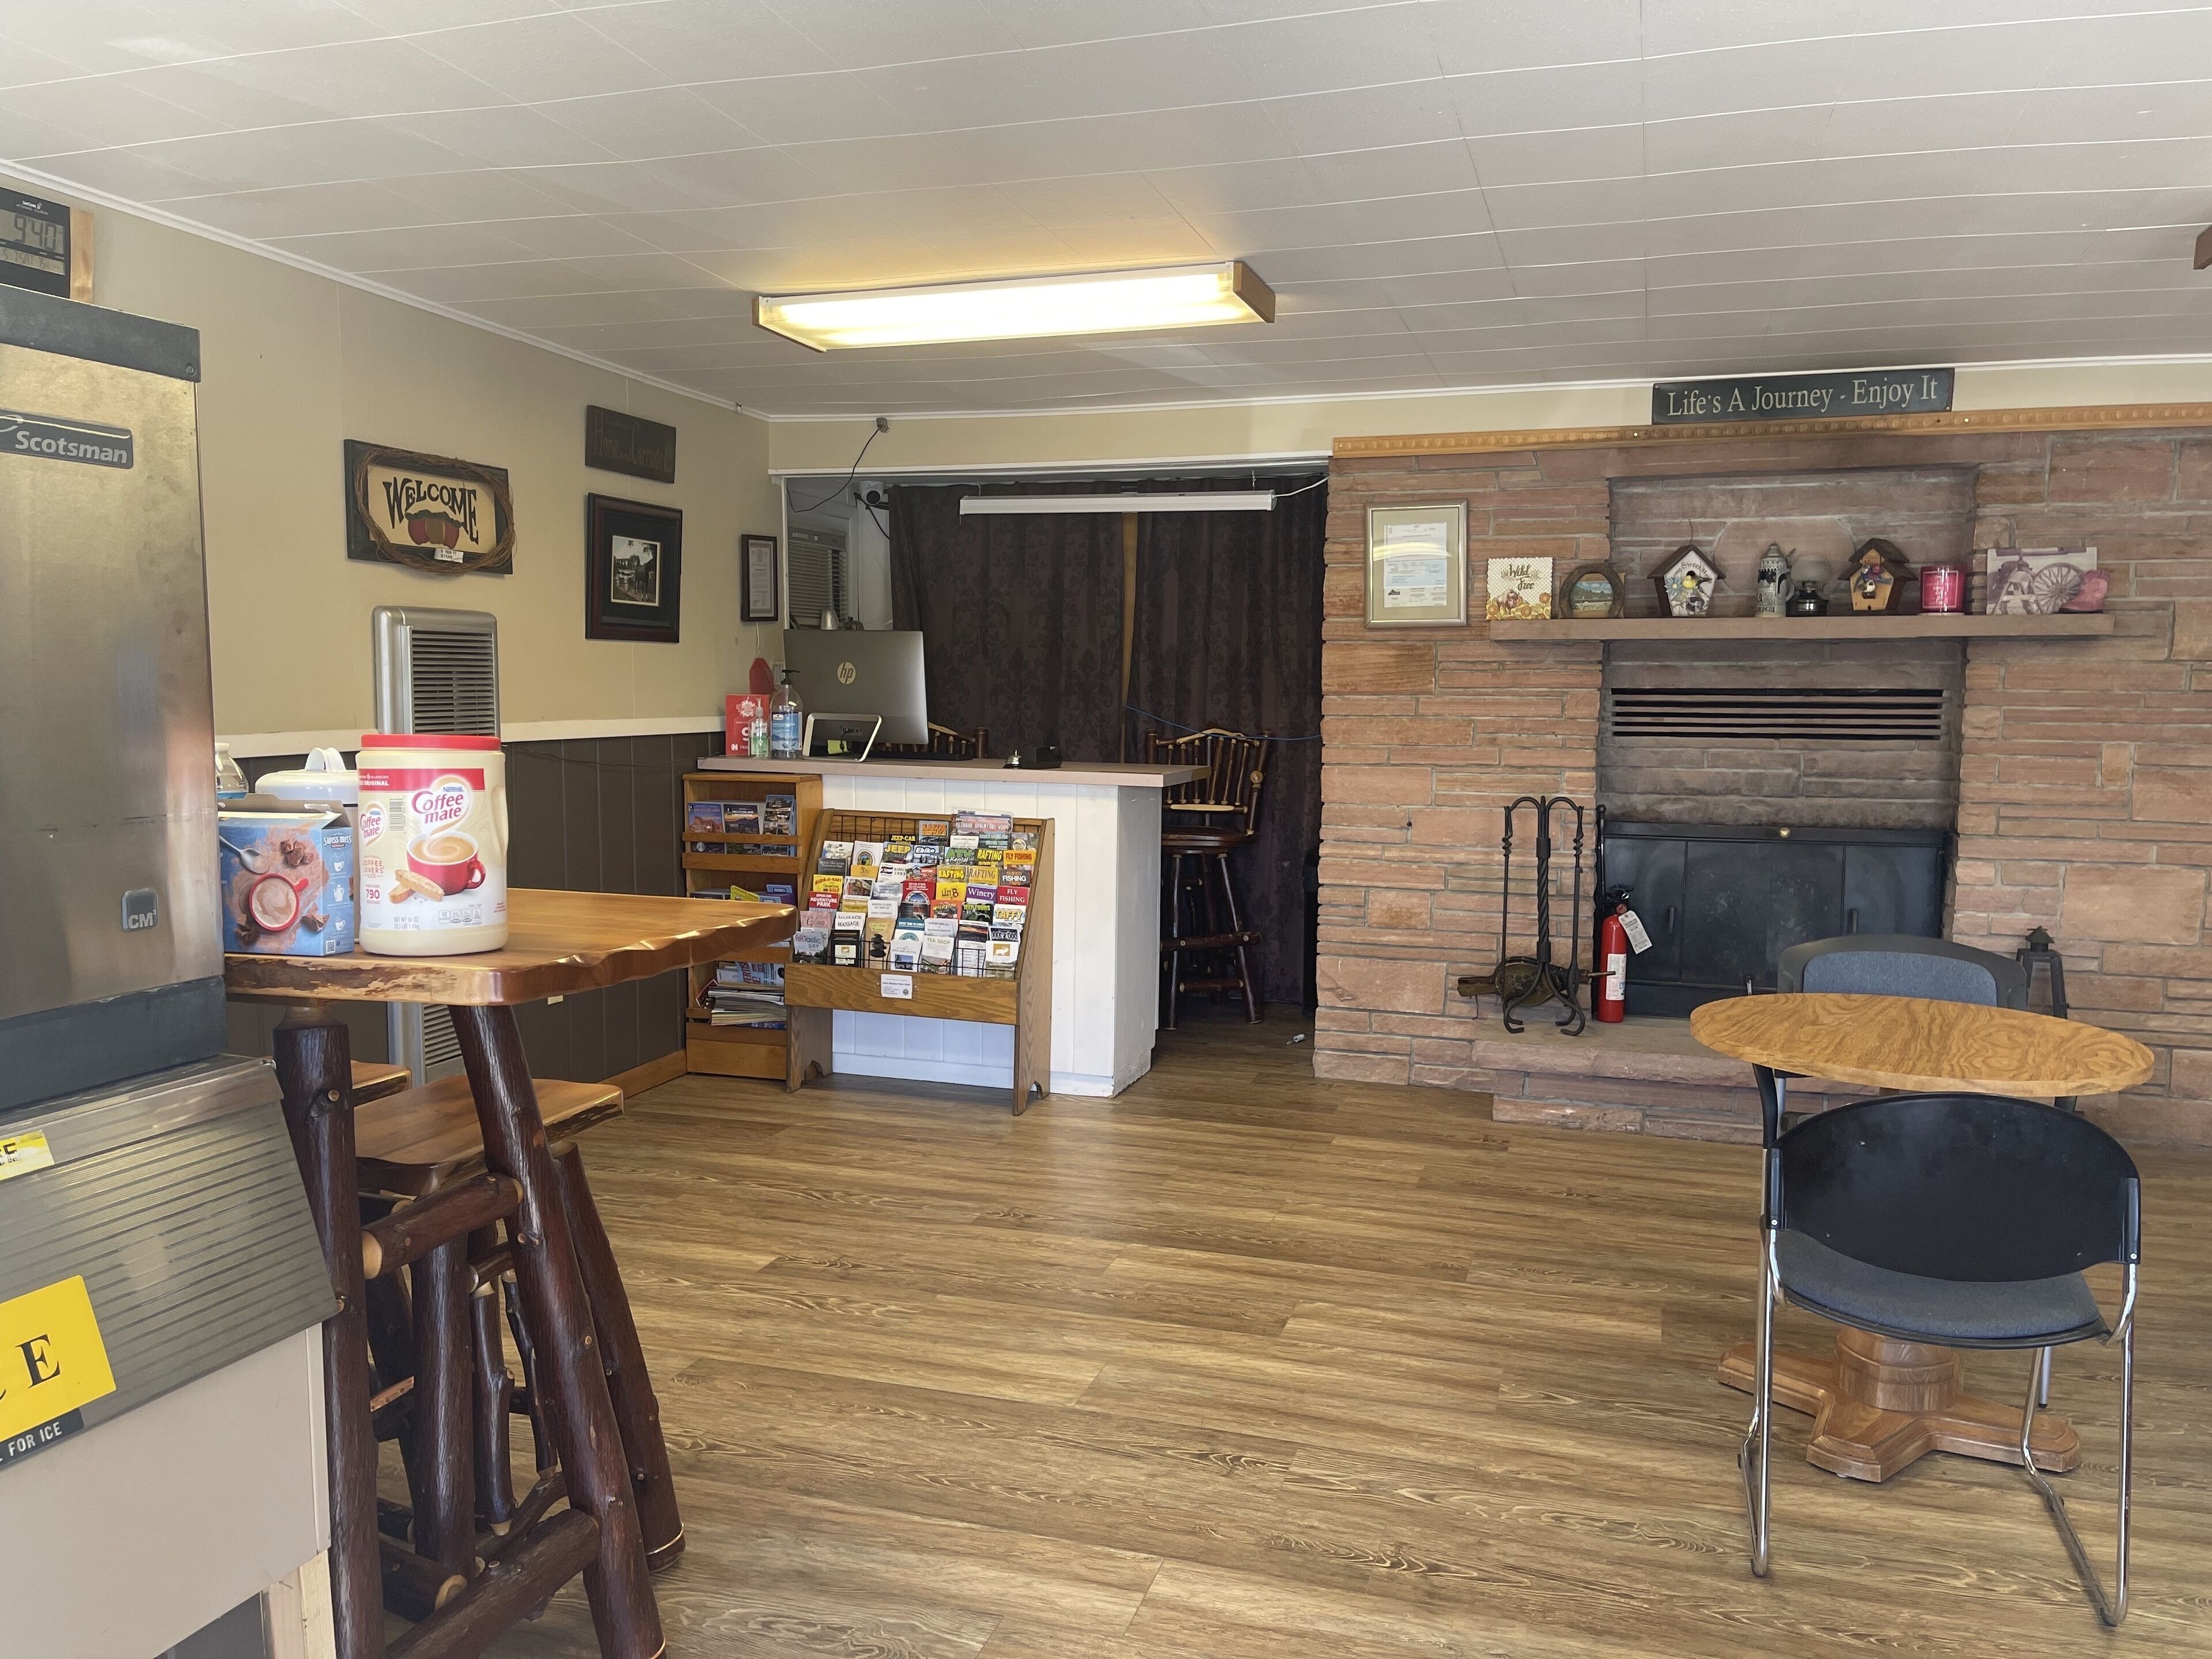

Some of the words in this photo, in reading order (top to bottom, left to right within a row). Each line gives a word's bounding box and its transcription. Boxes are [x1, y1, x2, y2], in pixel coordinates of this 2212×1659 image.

[1668, 389, 1721, 416] Life's
[1727, 387, 1745, 413] A
[1751, 385, 1833, 413] Journey
[1851, 377, 1915, 408] Enjoy
[1920, 374, 1938, 400] It
[15, 430, 128, 464] Scotsman
[382, 475, 479, 546] WELCOME
[1508, 564, 1532, 578] Wild
[1681, 562, 1701, 571] Sweet
[1516, 575, 1535, 590] Free
[839, 662, 855, 685] hp
[411, 790, 464, 815] Coffee
[424, 806, 462, 824] mate
[360, 813, 381, 831] Coffee
[363, 826, 380, 839] mate
[323, 836, 339, 846] SWISS
[340, 835, 352, 844] MISS
[884, 844, 912, 854] JEEP
[945, 848, 974, 859] ATV
[976, 849, 1003, 861] RAFTING
[1014, 853, 1032, 861] FISHING
[938, 870, 965, 879] RAFTING
[969, 867, 995, 880] RAFTING
[366, 889, 380, 899] 790
[952, 888, 959, 899] B
[968, 887, 995, 900] Winery
[995, 910, 1024, 921] TAFFY
[795, 934, 821, 944] ARTastic
[8, 1434, 36, 1457] FOR
[39, 1421, 62, 1442] ICE
